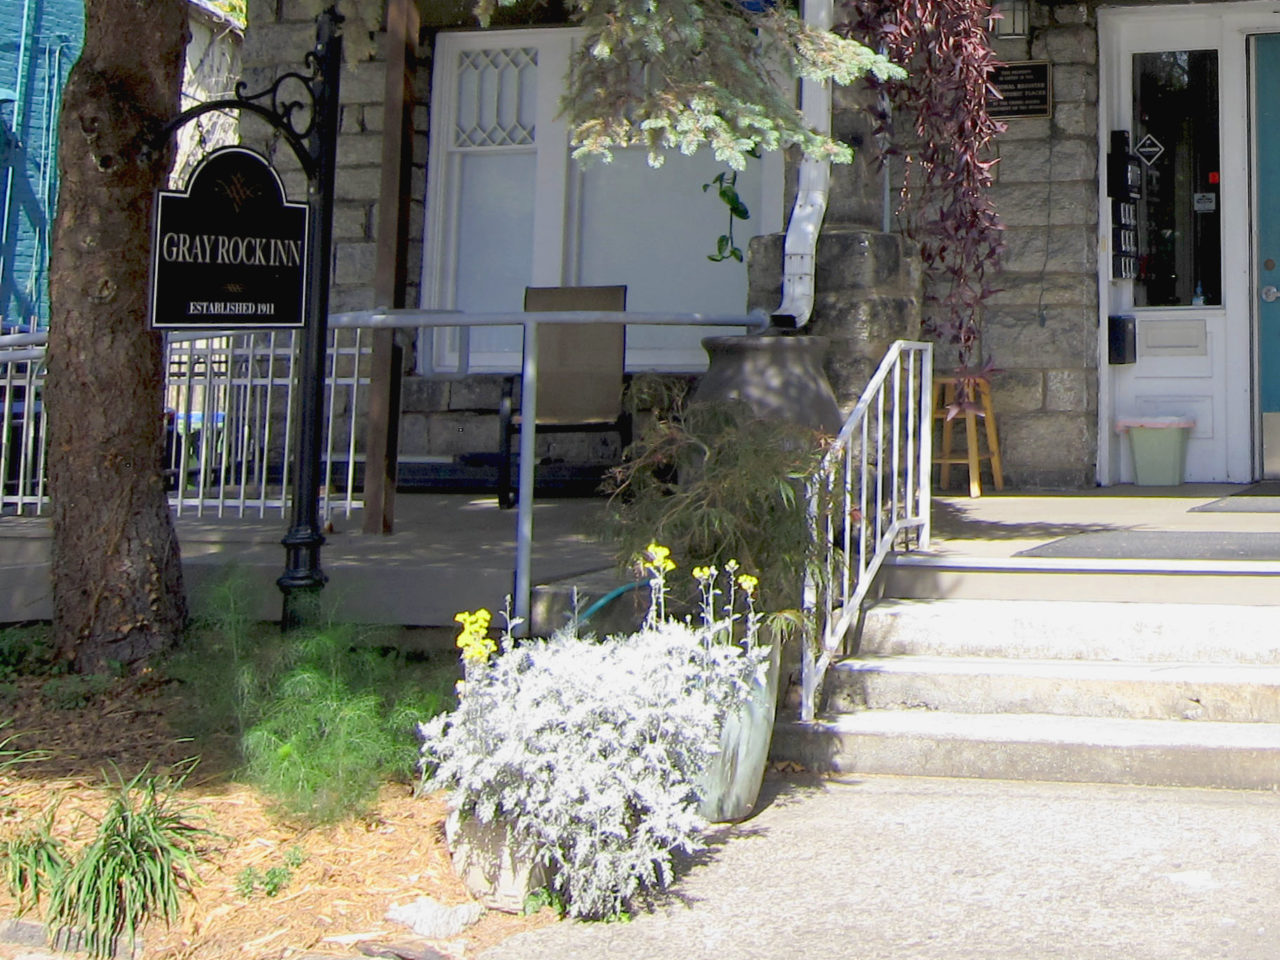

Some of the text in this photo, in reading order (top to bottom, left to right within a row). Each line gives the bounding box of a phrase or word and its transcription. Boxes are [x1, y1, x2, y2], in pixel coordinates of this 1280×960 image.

[163, 232, 302, 266] GRAY ROCK INN
[189, 302, 275, 315] ESTABLISHED 1911
